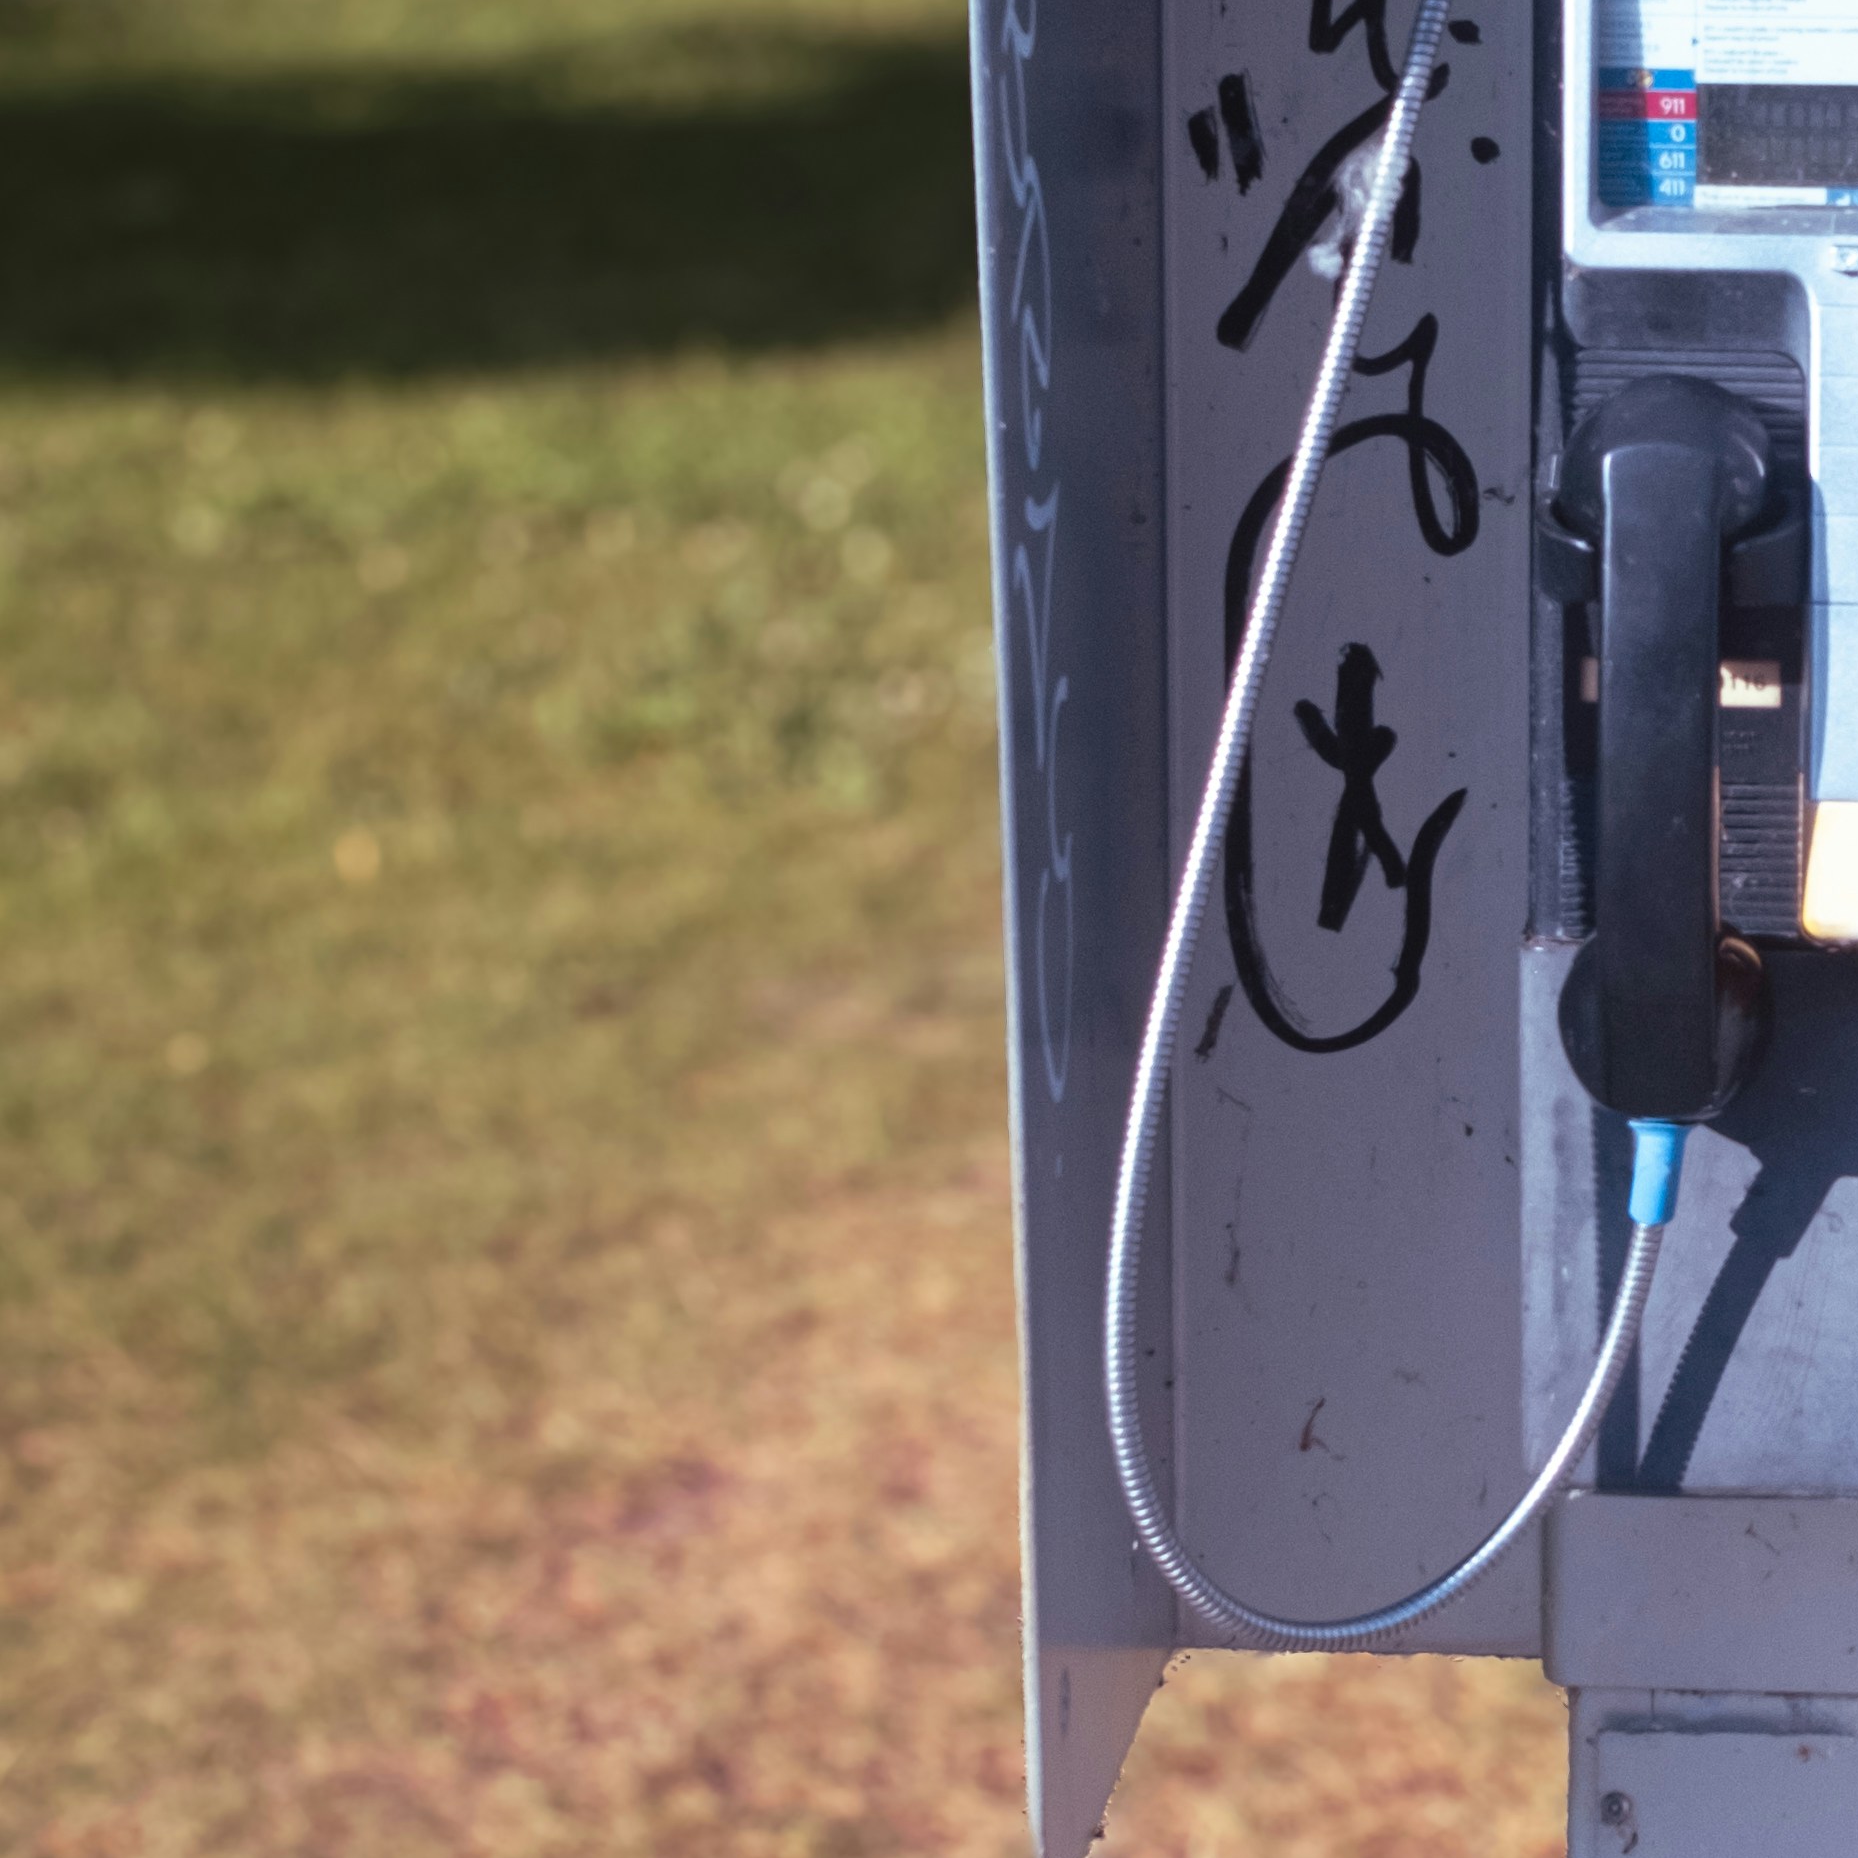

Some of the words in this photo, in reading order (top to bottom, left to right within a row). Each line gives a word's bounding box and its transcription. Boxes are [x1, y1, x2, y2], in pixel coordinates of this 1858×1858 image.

[1660, 97, 1685, 115] 911
[1670, 124, 1686, 143] 0
[1659, 151, 1685, 170] 611
[1659, 178, 1685, 196] 411
